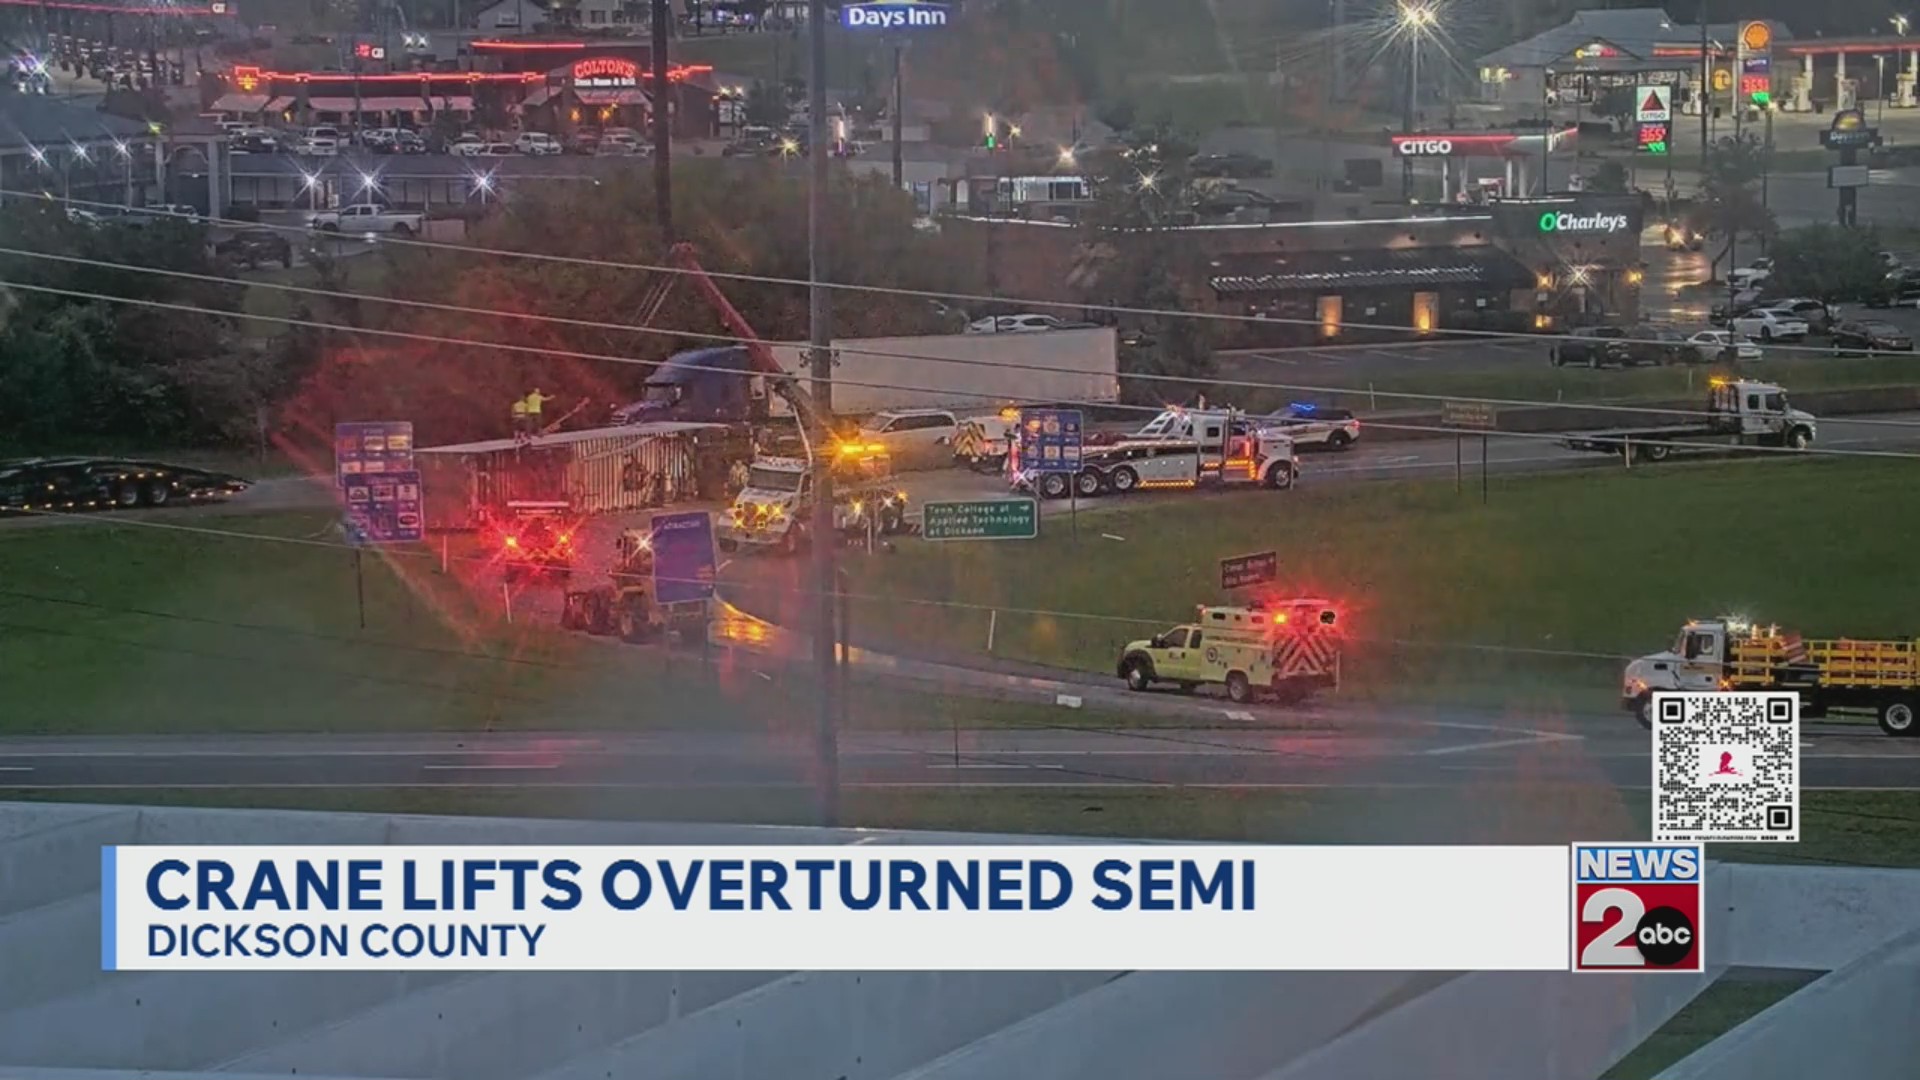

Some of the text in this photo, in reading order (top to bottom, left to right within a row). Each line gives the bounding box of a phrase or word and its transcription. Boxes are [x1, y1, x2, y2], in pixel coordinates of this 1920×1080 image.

[849, 7, 946, 28] Days Inn
[574, 60, 636, 78] COLTON'S
[1399, 140, 1452, 154] CITGO
[1540, 210, 1627, 232] O'Charley's
[929, 504, 1009, 514] Tenn College at
[930, 515, 1030, 526] Applied Technology
[929, 527, 940, 536] at
